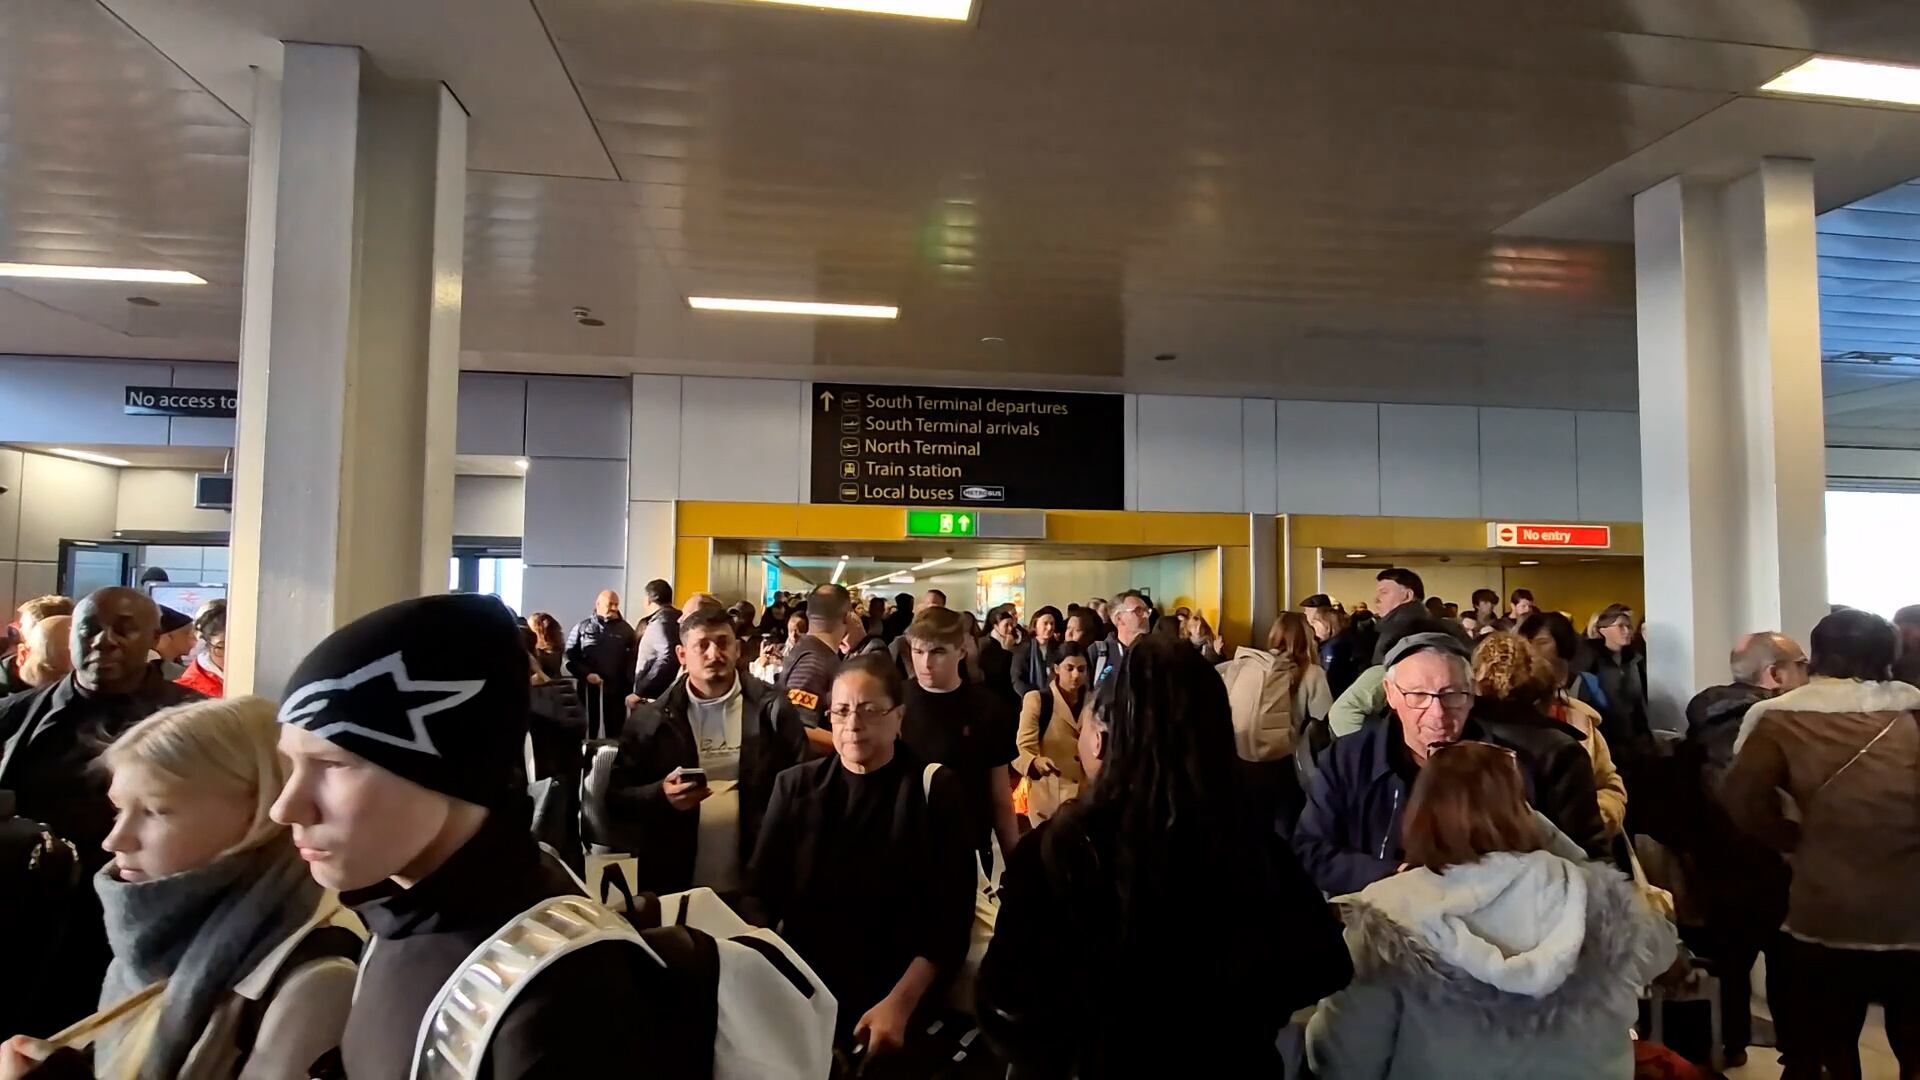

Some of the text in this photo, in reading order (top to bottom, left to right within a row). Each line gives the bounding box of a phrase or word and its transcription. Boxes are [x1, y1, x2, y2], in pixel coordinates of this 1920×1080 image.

[129, 391, 238, 409] No access to
[866, 394, 1068, 416] South Terminal departures
[866, 416, 1040, 436] South Terminal arrivals
[865, 439, 980, 456] North Terminal
[866, 461, 962, 478] Train station
[864, 484, 955, 500] Local buses
[1523, 529, 1571, 544] No entry
